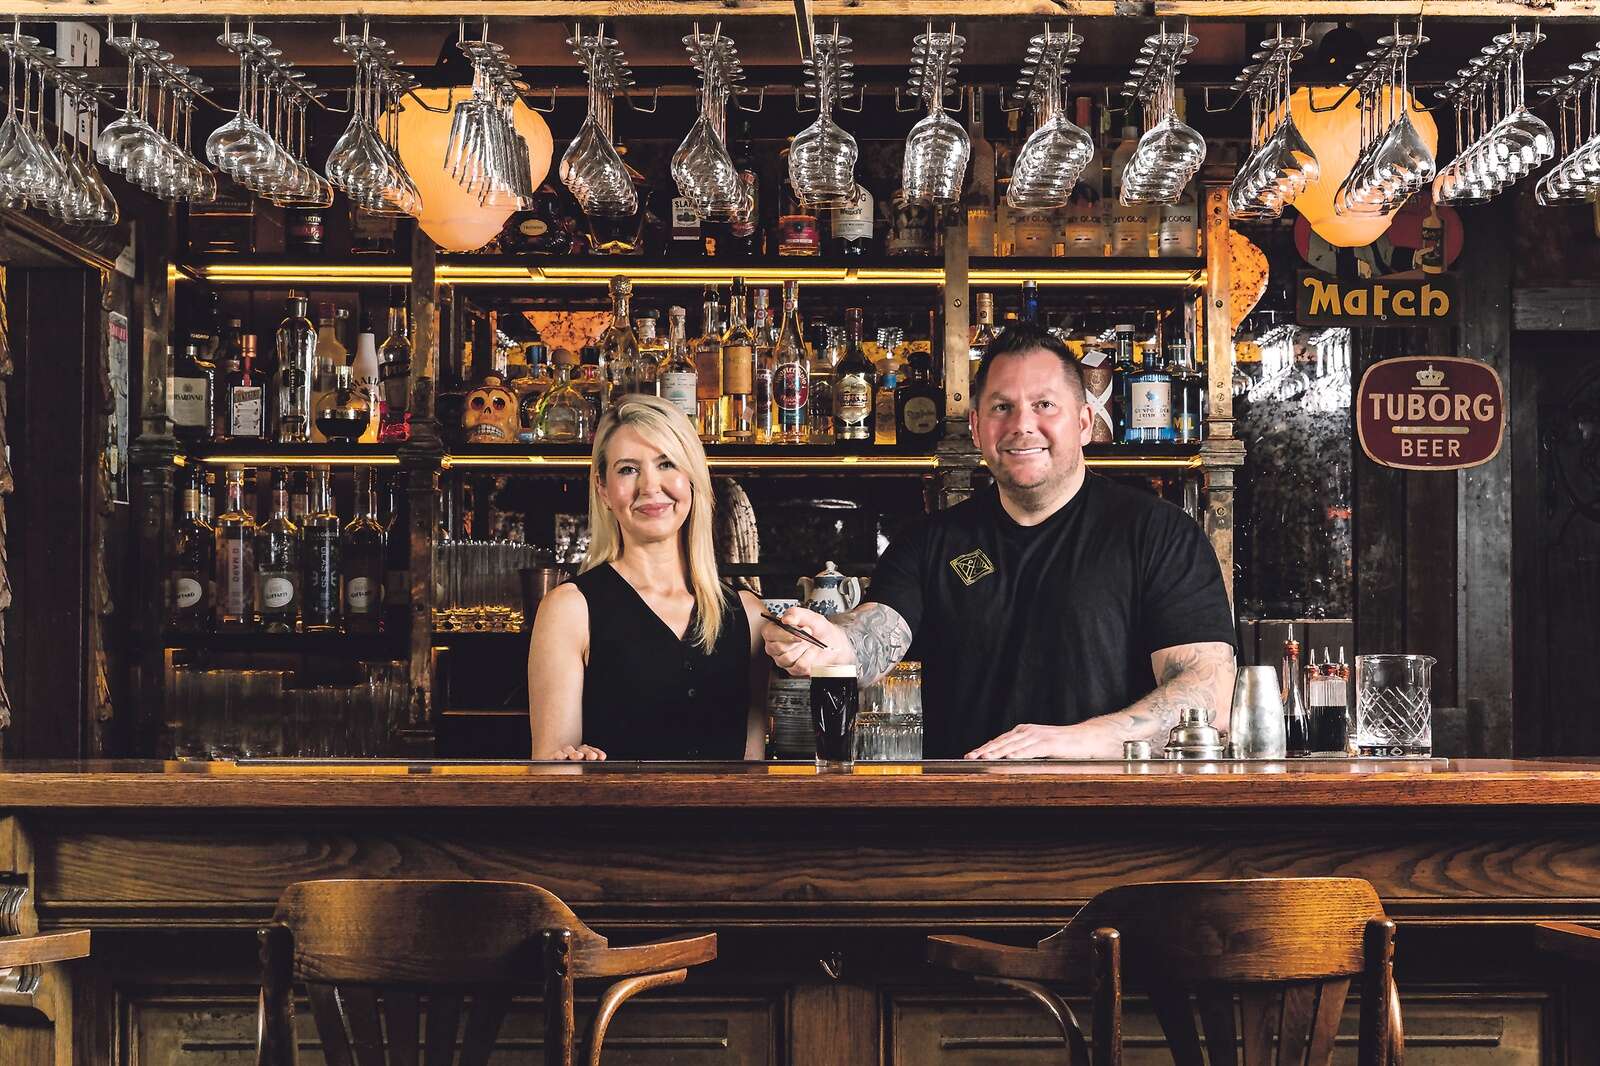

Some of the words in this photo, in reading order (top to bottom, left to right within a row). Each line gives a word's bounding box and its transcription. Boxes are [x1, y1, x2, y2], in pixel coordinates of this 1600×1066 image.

[1303, 277, 1450, 317] Match
[1369, 393, 1495, 422] TUBORG
[1401, 439, 1461, 457] BEER
